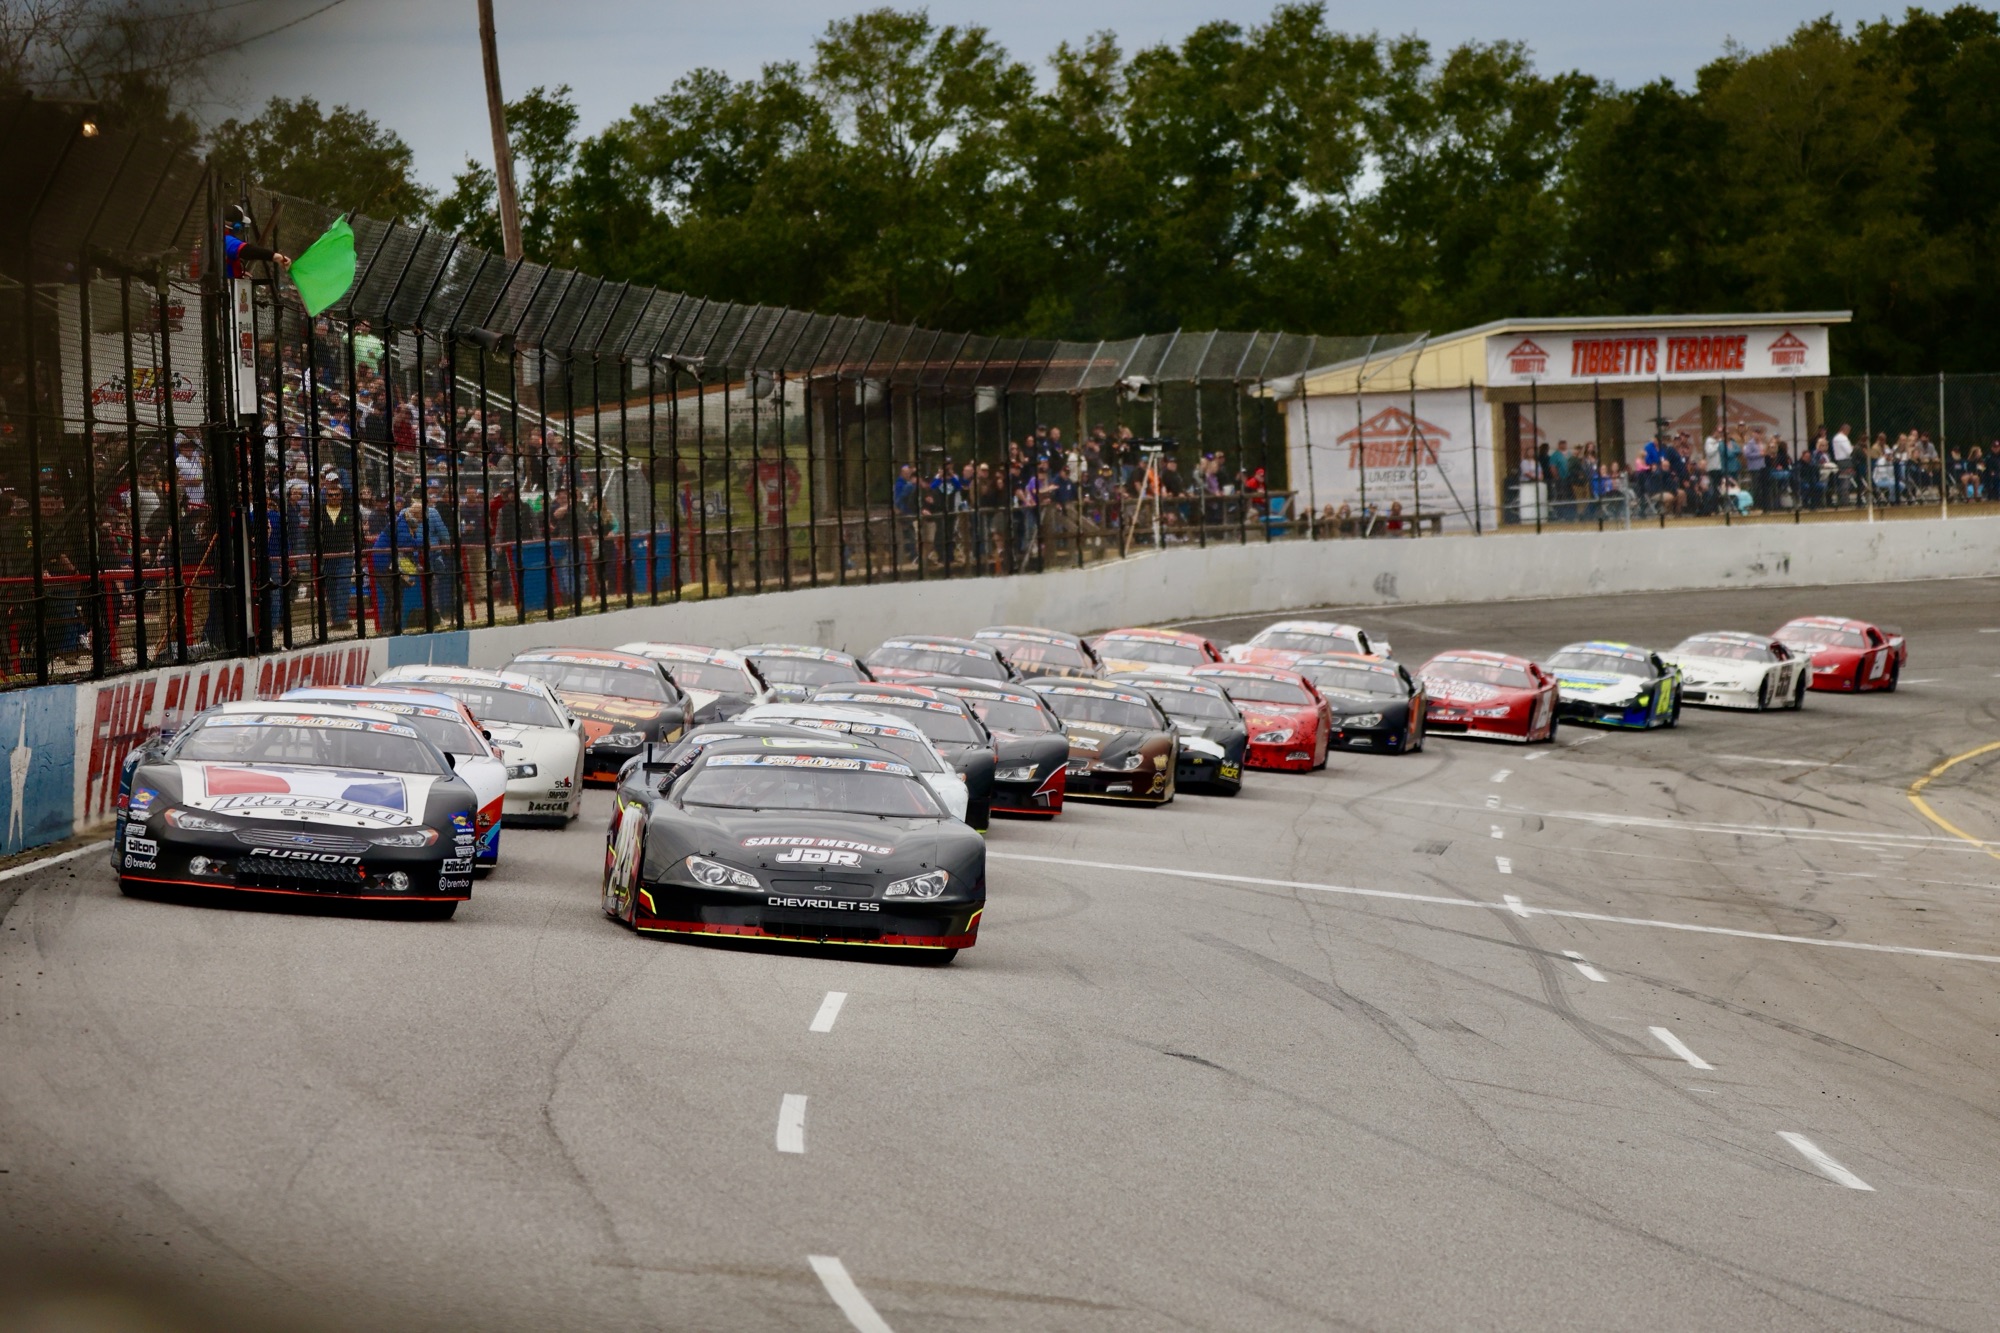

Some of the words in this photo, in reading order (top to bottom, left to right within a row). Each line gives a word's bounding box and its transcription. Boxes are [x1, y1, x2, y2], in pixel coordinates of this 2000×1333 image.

[1571, 337, 1657, 376] TIBBETTS
[1666, 335, 1747, 373] TERRACE
[1771, 350, 1805, 365] TIBBETTS
[1510, 358, 1546, 374] TIBBETTS
[1348, 438, 1442, 470] TIBBETTS
[591, 712, 637, 728] Company
[84, 678, 158, 822] FIVE
[767, 756, 821, 769] SNOWBALL
[821, 757, 861, 770] DERBY
[212, 795, 411, 826] iRacing
[528, 801, 570, 812] RACECAR
[128, 839, 156, 854] tilton
[744, 837, 815, 847] SALTED
[817, 838, 891, 855] METALS
[133, 857, 156, 870] brembo
[250, 847, 362, 865] FUSION
[776, 847, 862, 868] JDR
[445, 861, 471, 872] tilton
[447, 879, 470, 888] brembo
[767, 896, 857, 911] CHEVROLET
[859, 903, 880, 912] SS
